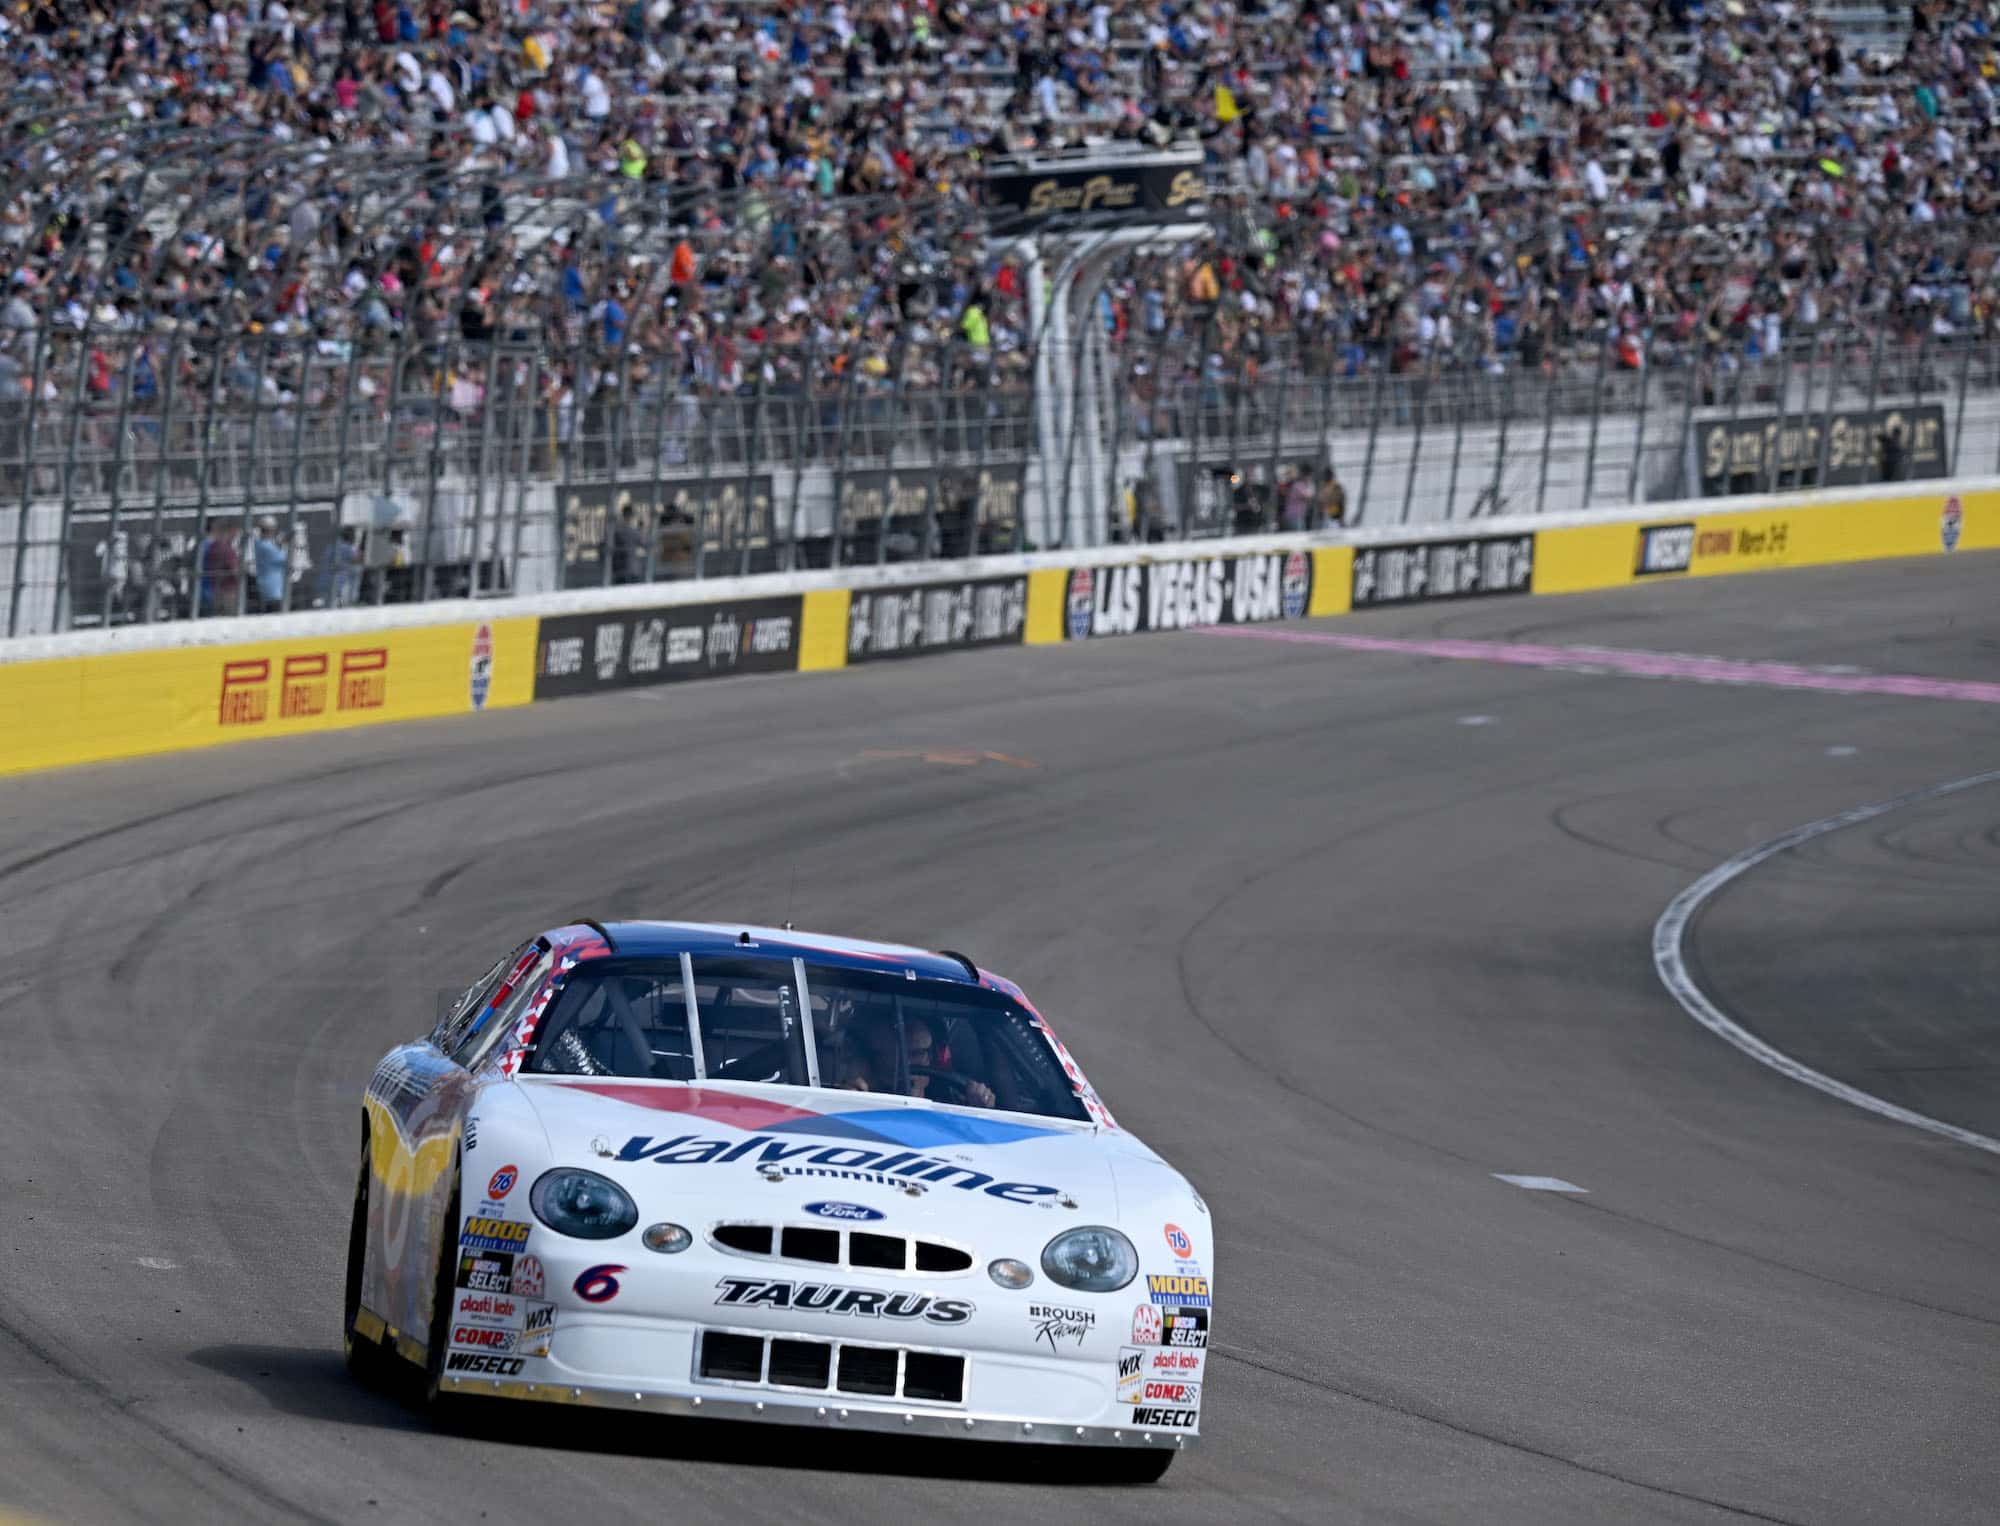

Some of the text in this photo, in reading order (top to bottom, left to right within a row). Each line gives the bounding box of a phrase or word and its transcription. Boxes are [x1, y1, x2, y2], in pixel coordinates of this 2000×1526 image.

[1093, 563, 1142, 635] LAS
[1148, 556, 1225, 631] VEGAS
[1232, 552, 1282, 624] USA
[280, 653, 328, 718] PIRELLI
[336, 648, 388, 711] PIRELLI
[219, 659, 270, 725] PIRELLI
[614, 1134, 1061, 1205] Valvoline
[493, 1173, 513, 1191] 76
[819, 1202, 870, 1219] Ford
[464, 1215, 532, 1242] MOOG
[1168, 1231, 1187, 1249] 76
[467, 1270, 511, 1292] SELECT
[572, 1263, 630, 1304] 6
[1148, 1274, 1208, 1296] MOOG
[459, 1294, 492, 1313] plasti
[716, 1276, 975, 1326] TAURUS
[525, 1305, 554, 1332] WIX
[454, 1327, 505, 1346] COMP
[1170, 1328, 1207, 1347] SELECT
[447, 1353, 526, 1376] WISECO
[1119, 1353, 1142, 1378] WIX
[1152, 1350, 1178, 1369] plasti
[1144, 1383, 1185, 1400] COMP
[1132, 1407, 1197, 1427] WISECO
